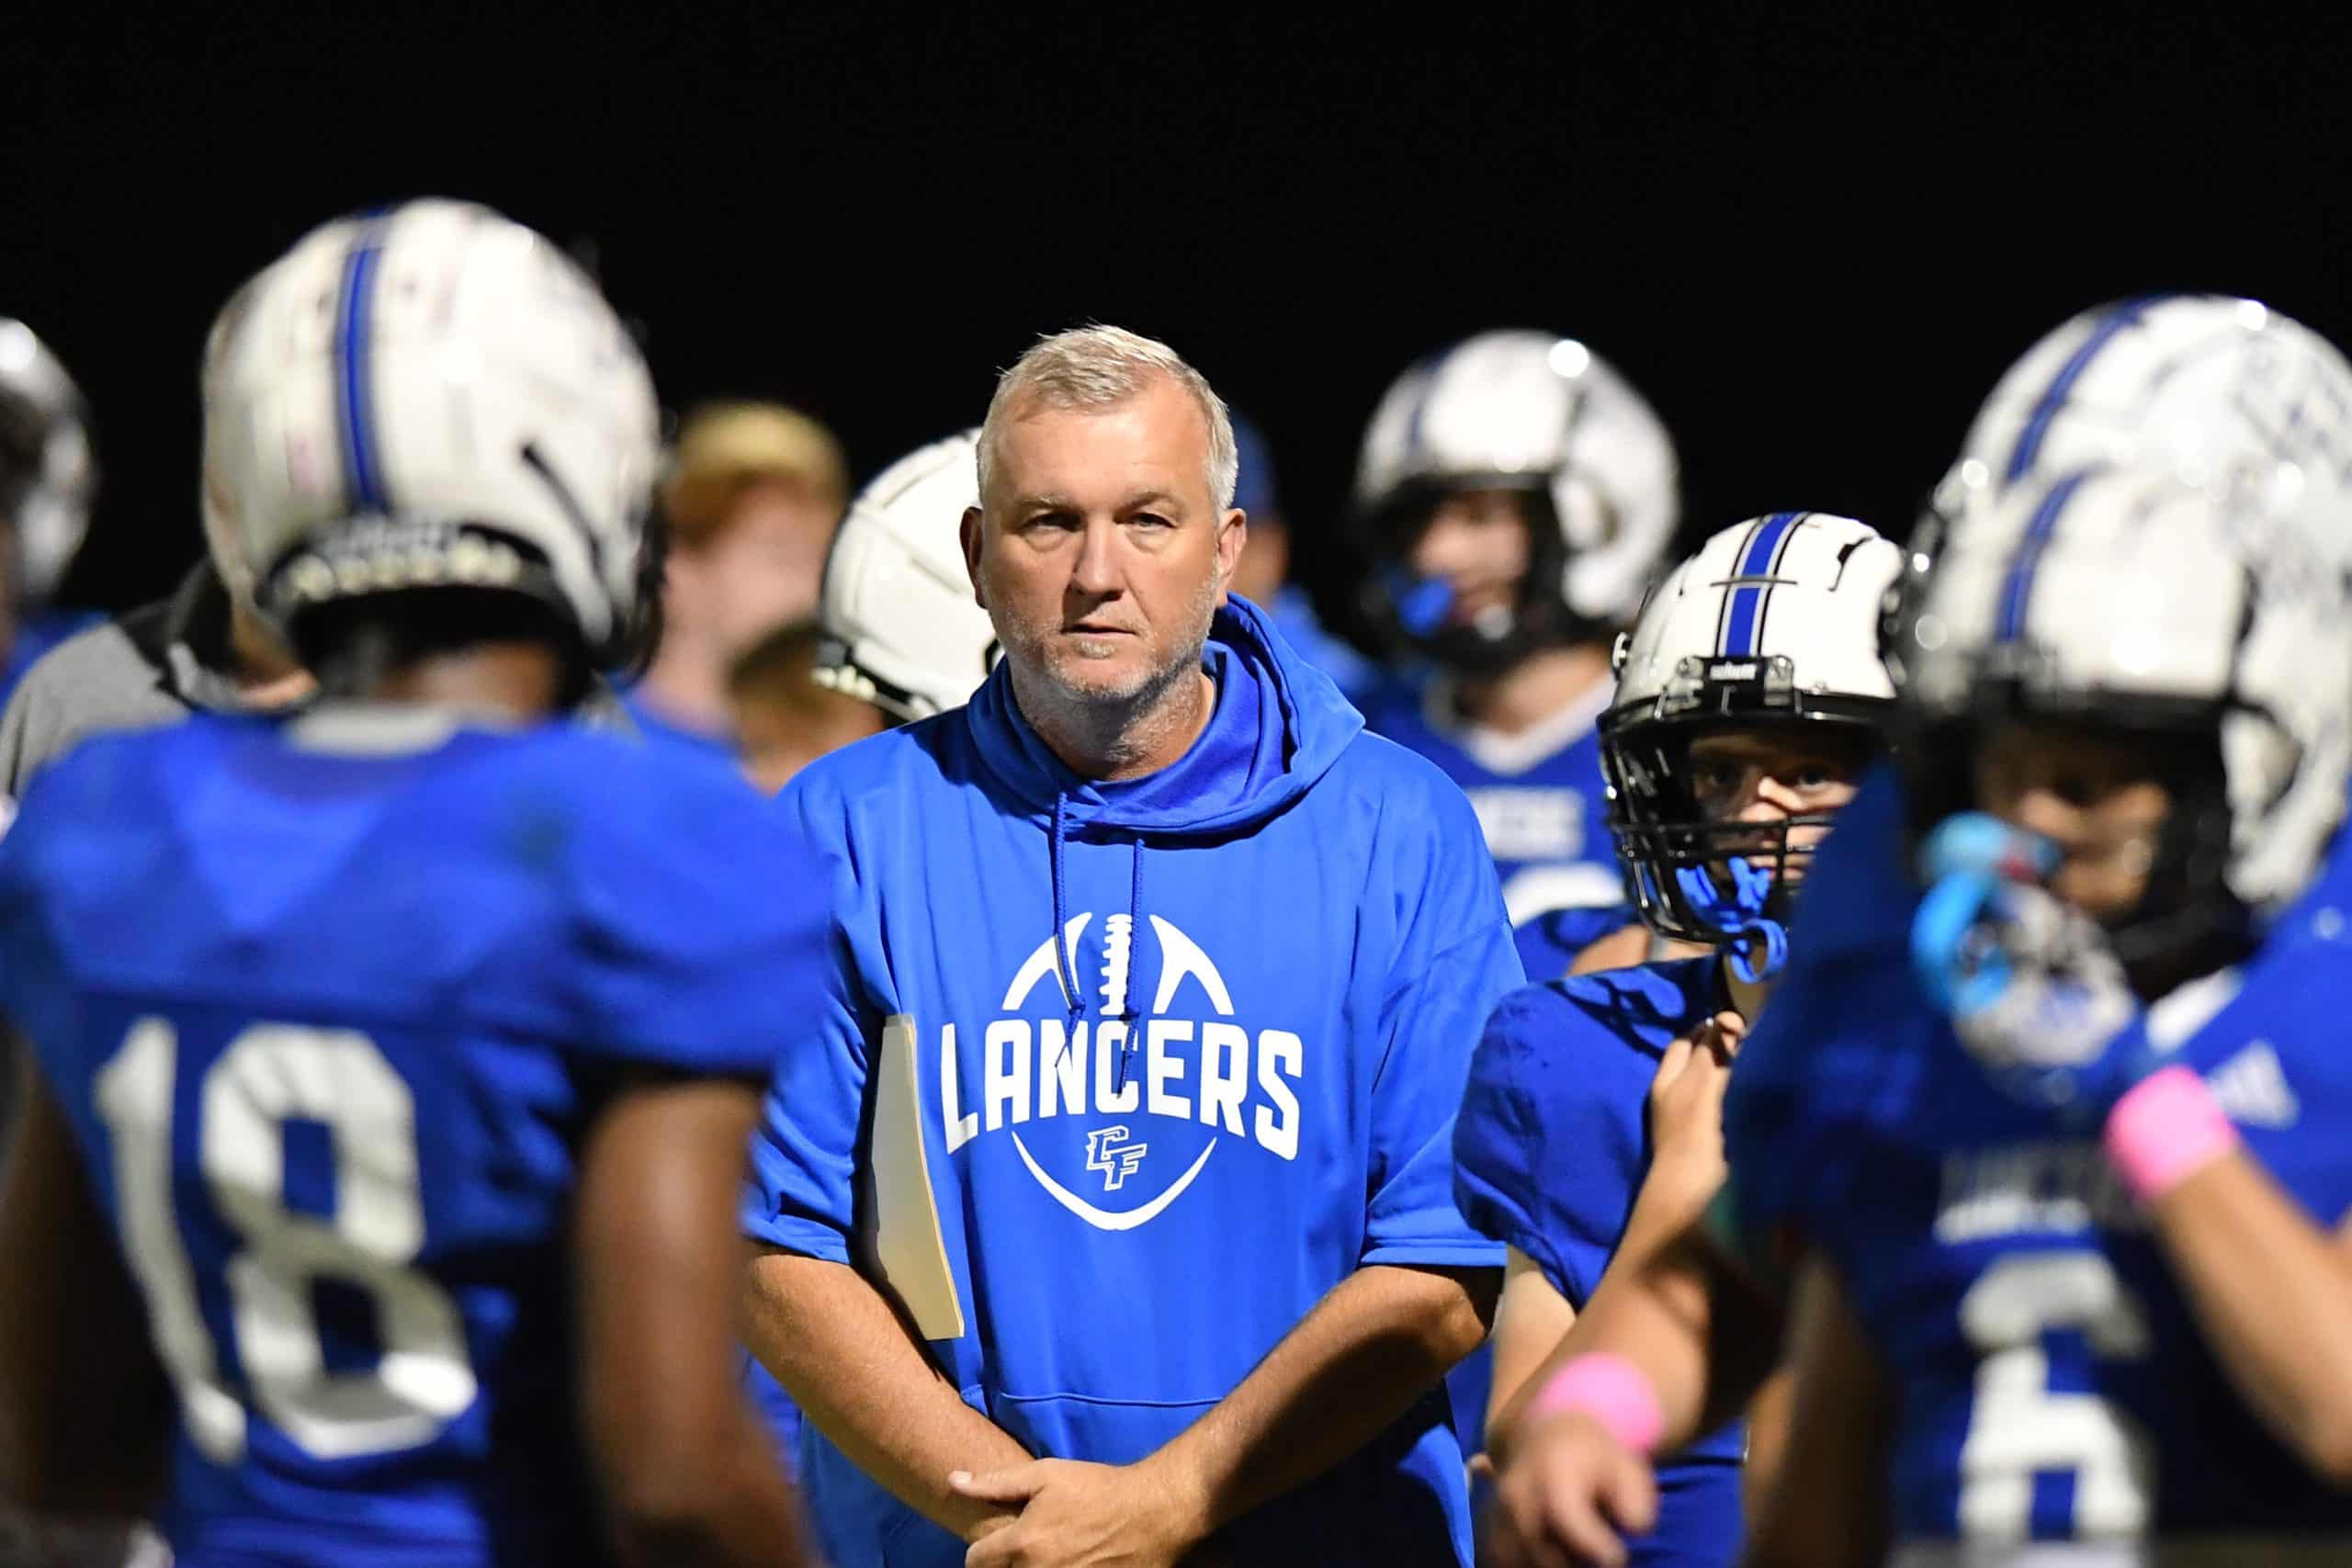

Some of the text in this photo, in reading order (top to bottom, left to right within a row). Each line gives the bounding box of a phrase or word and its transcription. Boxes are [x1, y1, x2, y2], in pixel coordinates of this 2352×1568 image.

[940, 1019, 1303, 1161] LANCERS
[1085, 1124, 1148, 1191] CF
[96, 1017, 479, 1461] 18
[1953, 1248, 2154, 1567] 6
